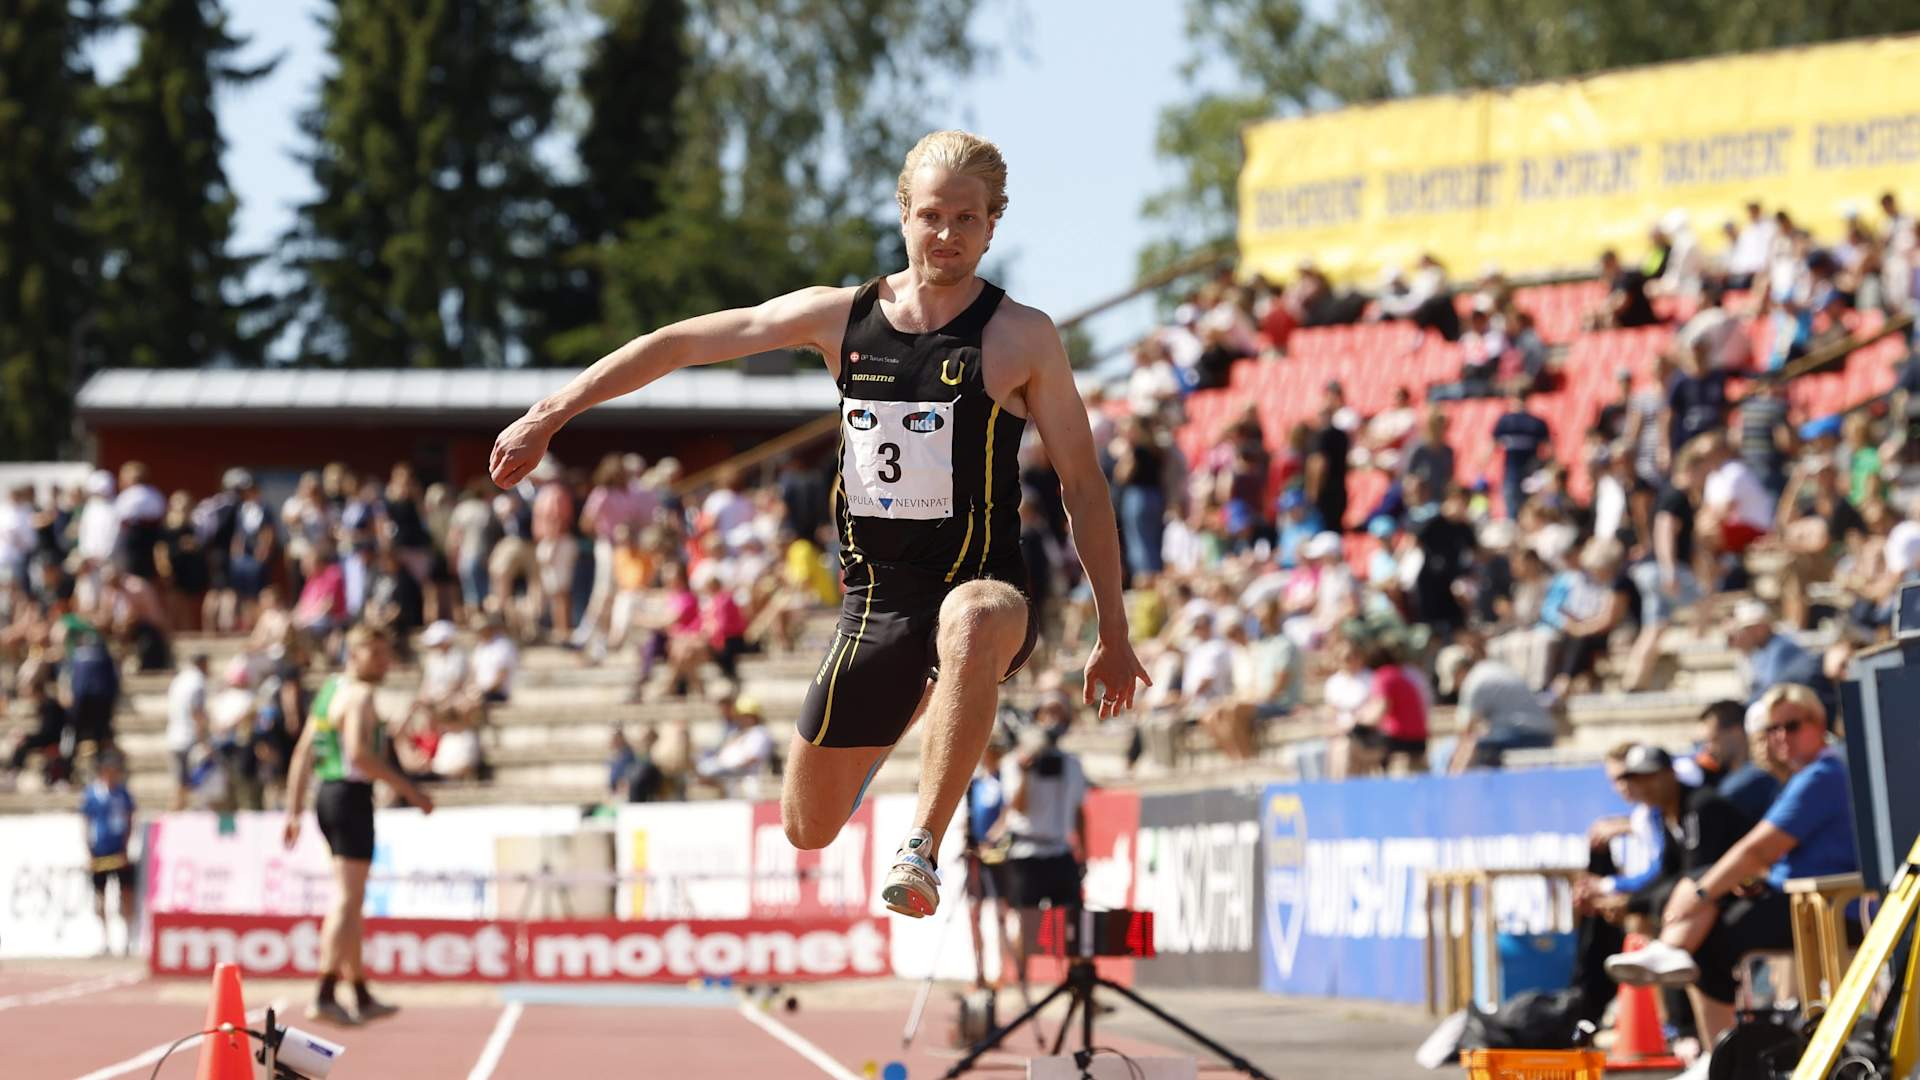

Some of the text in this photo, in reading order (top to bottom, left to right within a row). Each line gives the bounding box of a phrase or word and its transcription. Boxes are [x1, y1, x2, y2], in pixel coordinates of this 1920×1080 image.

[851, 373, 896, 383] noname
[909, 416, 936, 431] IKH
[878, 442, 902, 483] 3
[160, 921, 509, 977] motnet
[534, 919, 886, 977] motonet
